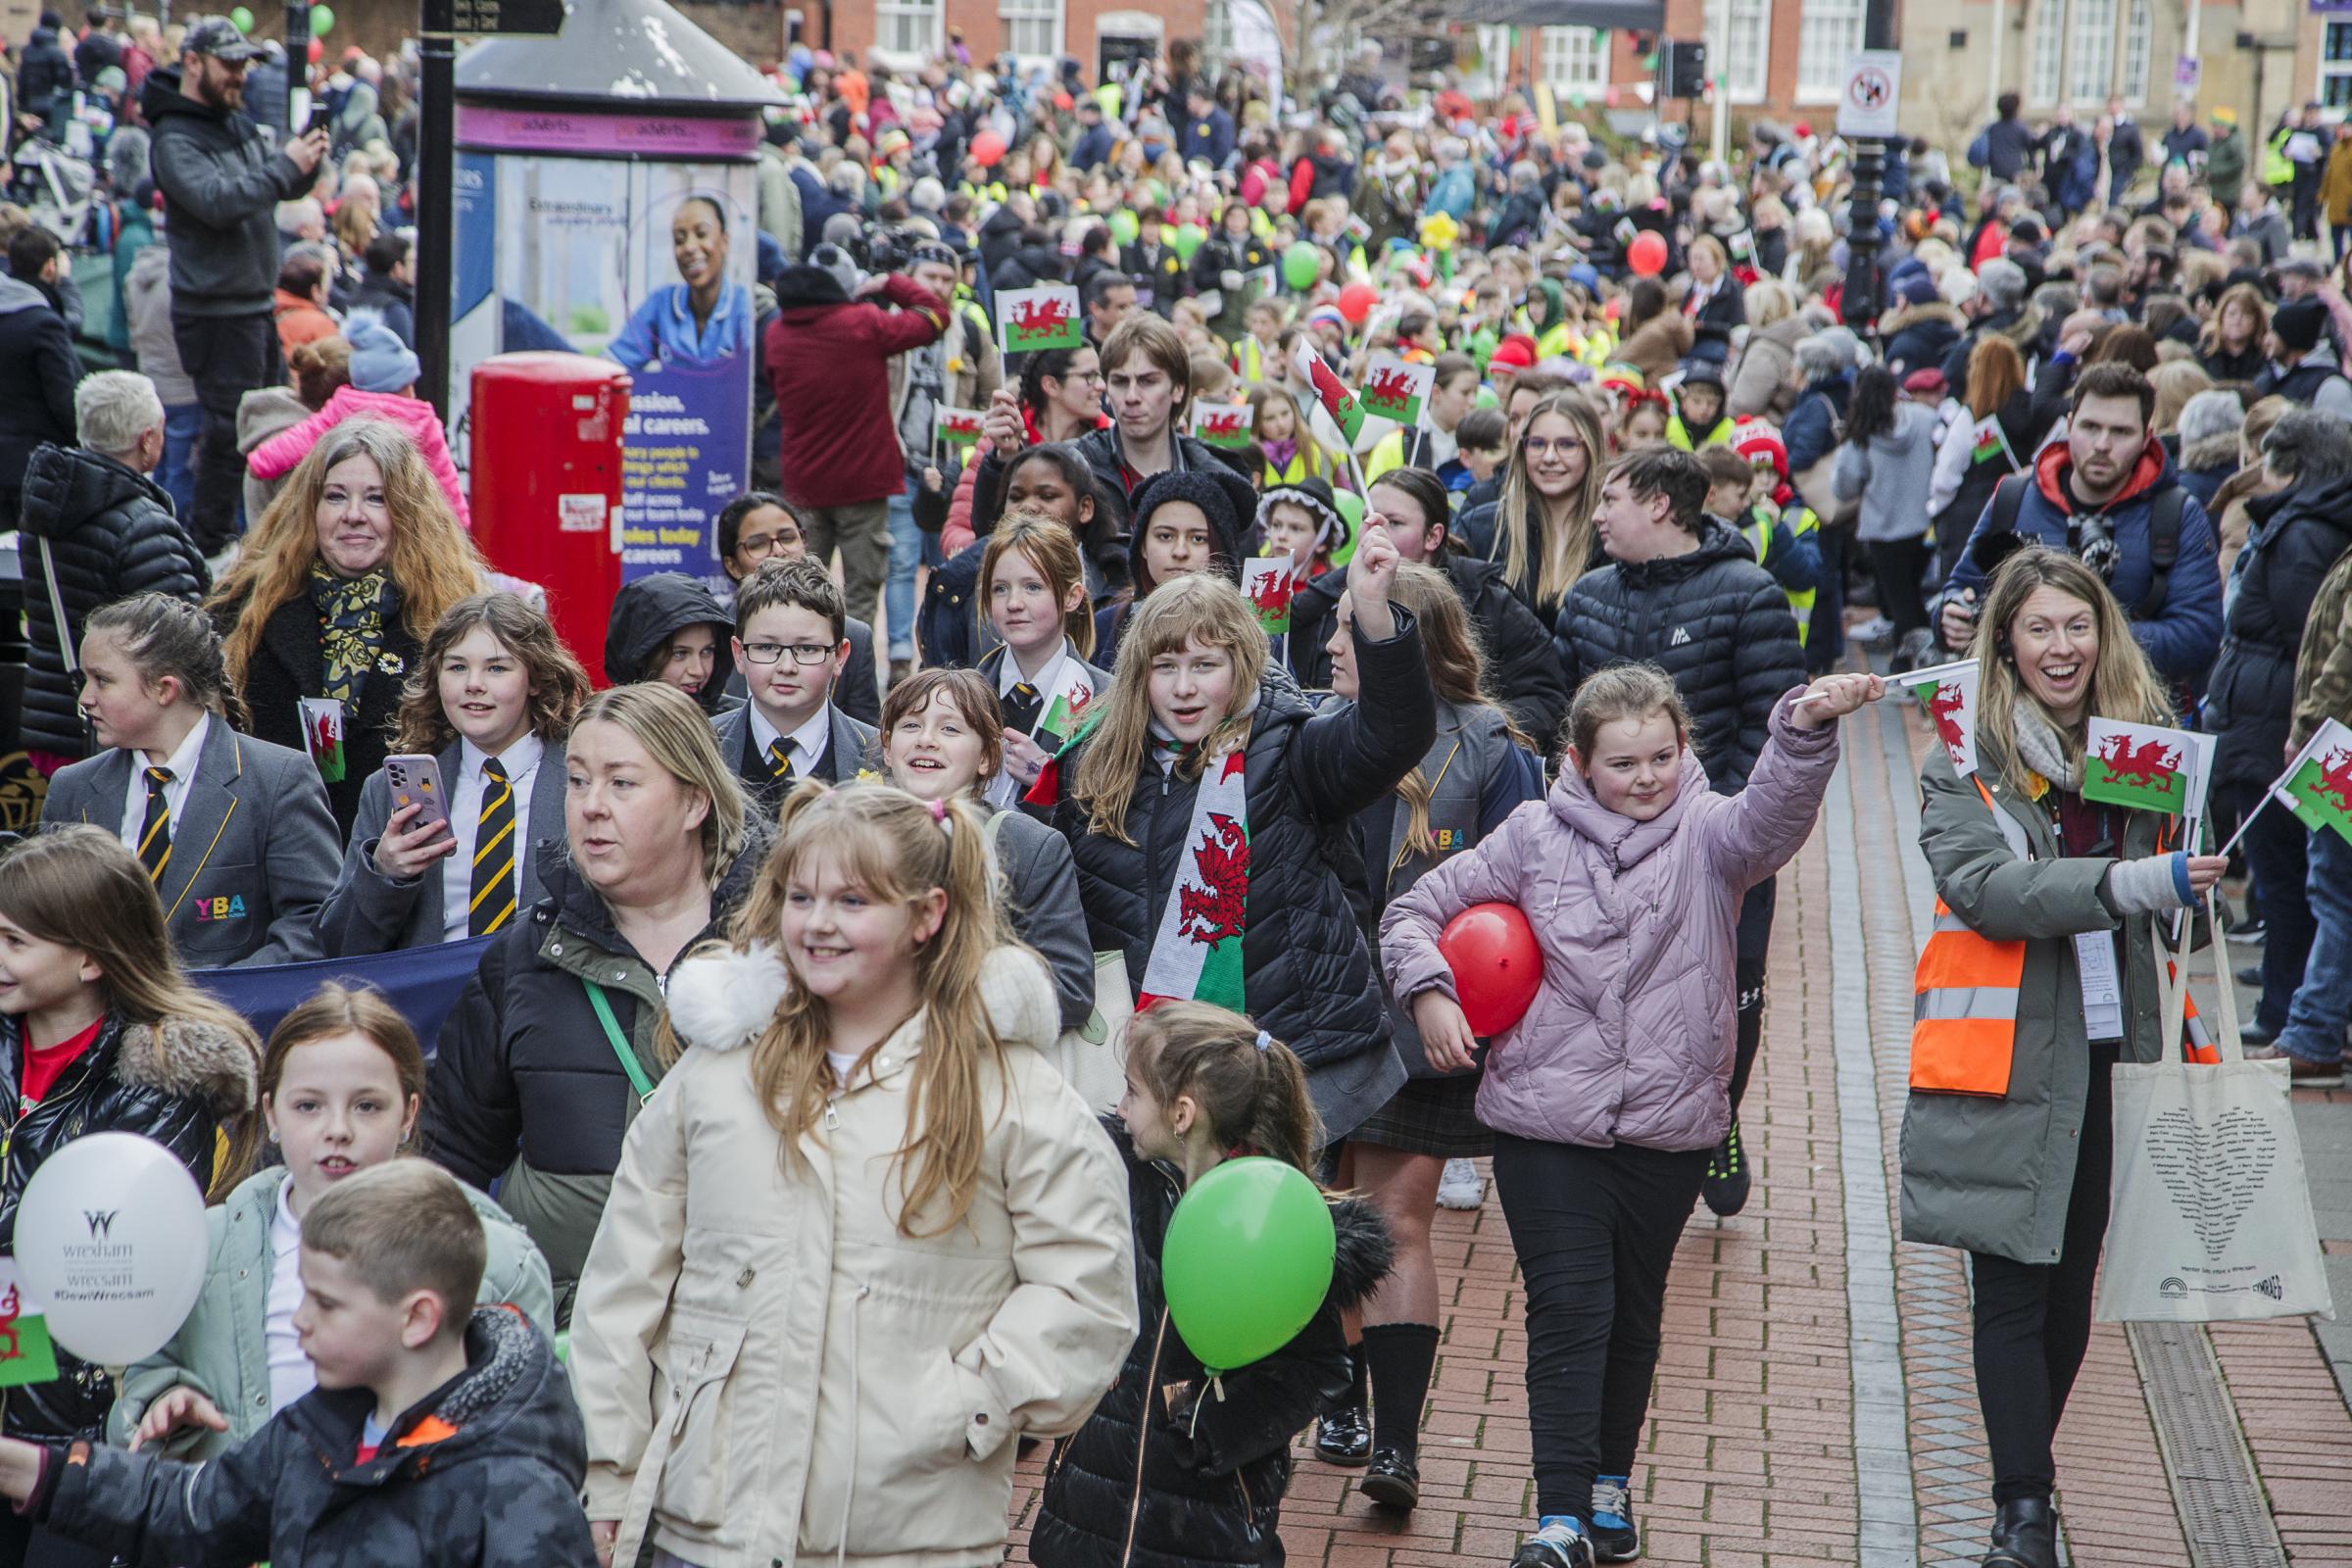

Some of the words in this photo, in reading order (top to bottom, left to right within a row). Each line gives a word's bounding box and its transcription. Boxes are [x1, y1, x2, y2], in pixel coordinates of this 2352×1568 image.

[629, 392, 685, 412] ssion.
[643, 417, 710, 435] careers.
[657, 461, 690, 473] which
[646, 495, 683, 507] across
[623, 526, 657, 544] oles
[659, 526, 701, 548] today
[621, 549, 682, 564] careers
[195, 895, 245, 916] YBA
[63, 1239, 132, 1257] wrexham
